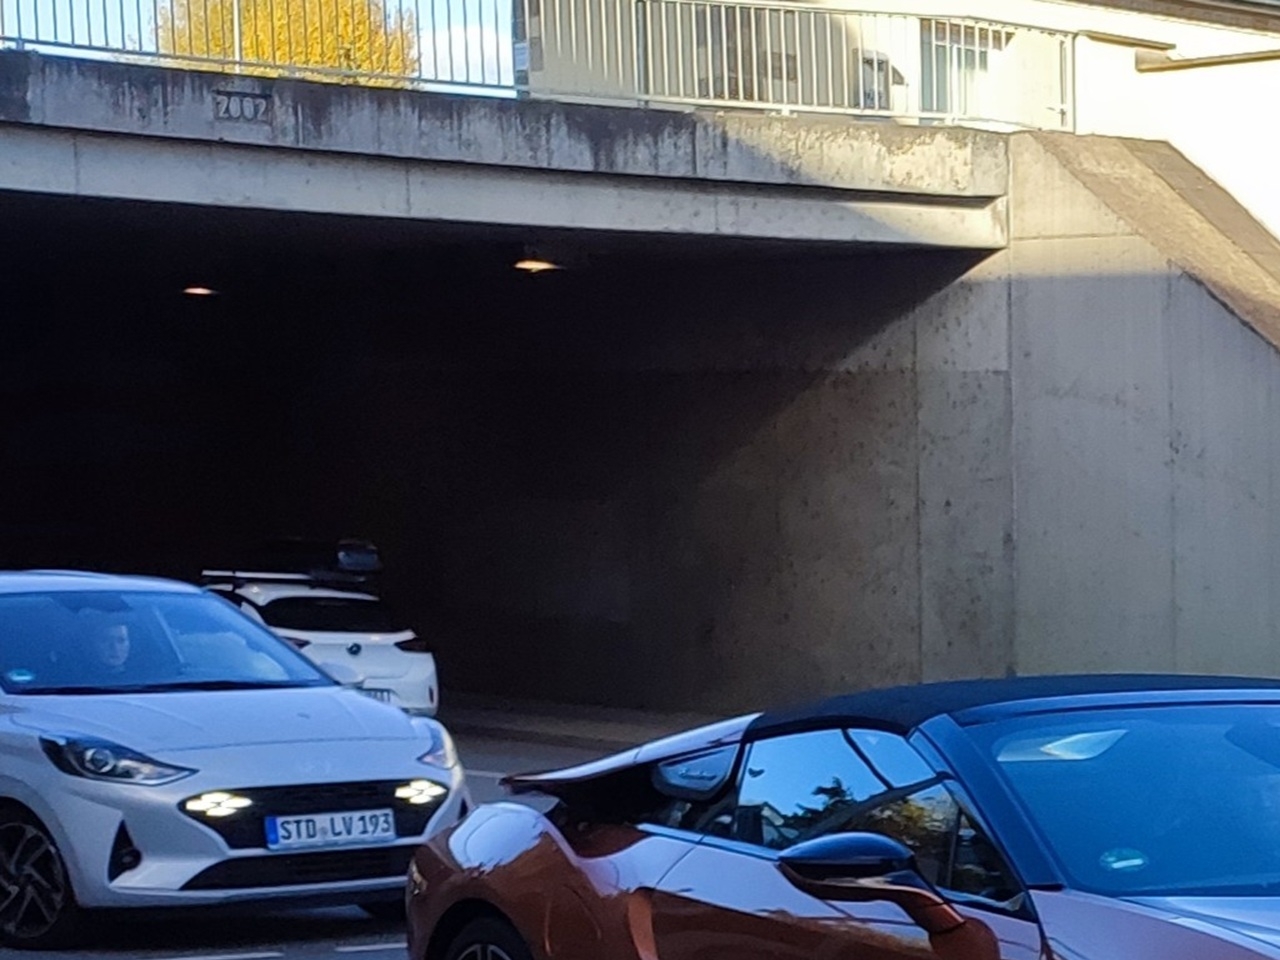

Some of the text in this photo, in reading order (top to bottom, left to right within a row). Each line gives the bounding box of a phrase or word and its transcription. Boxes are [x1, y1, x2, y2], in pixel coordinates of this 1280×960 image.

[280, 812, 392, 840] STD LV 193
